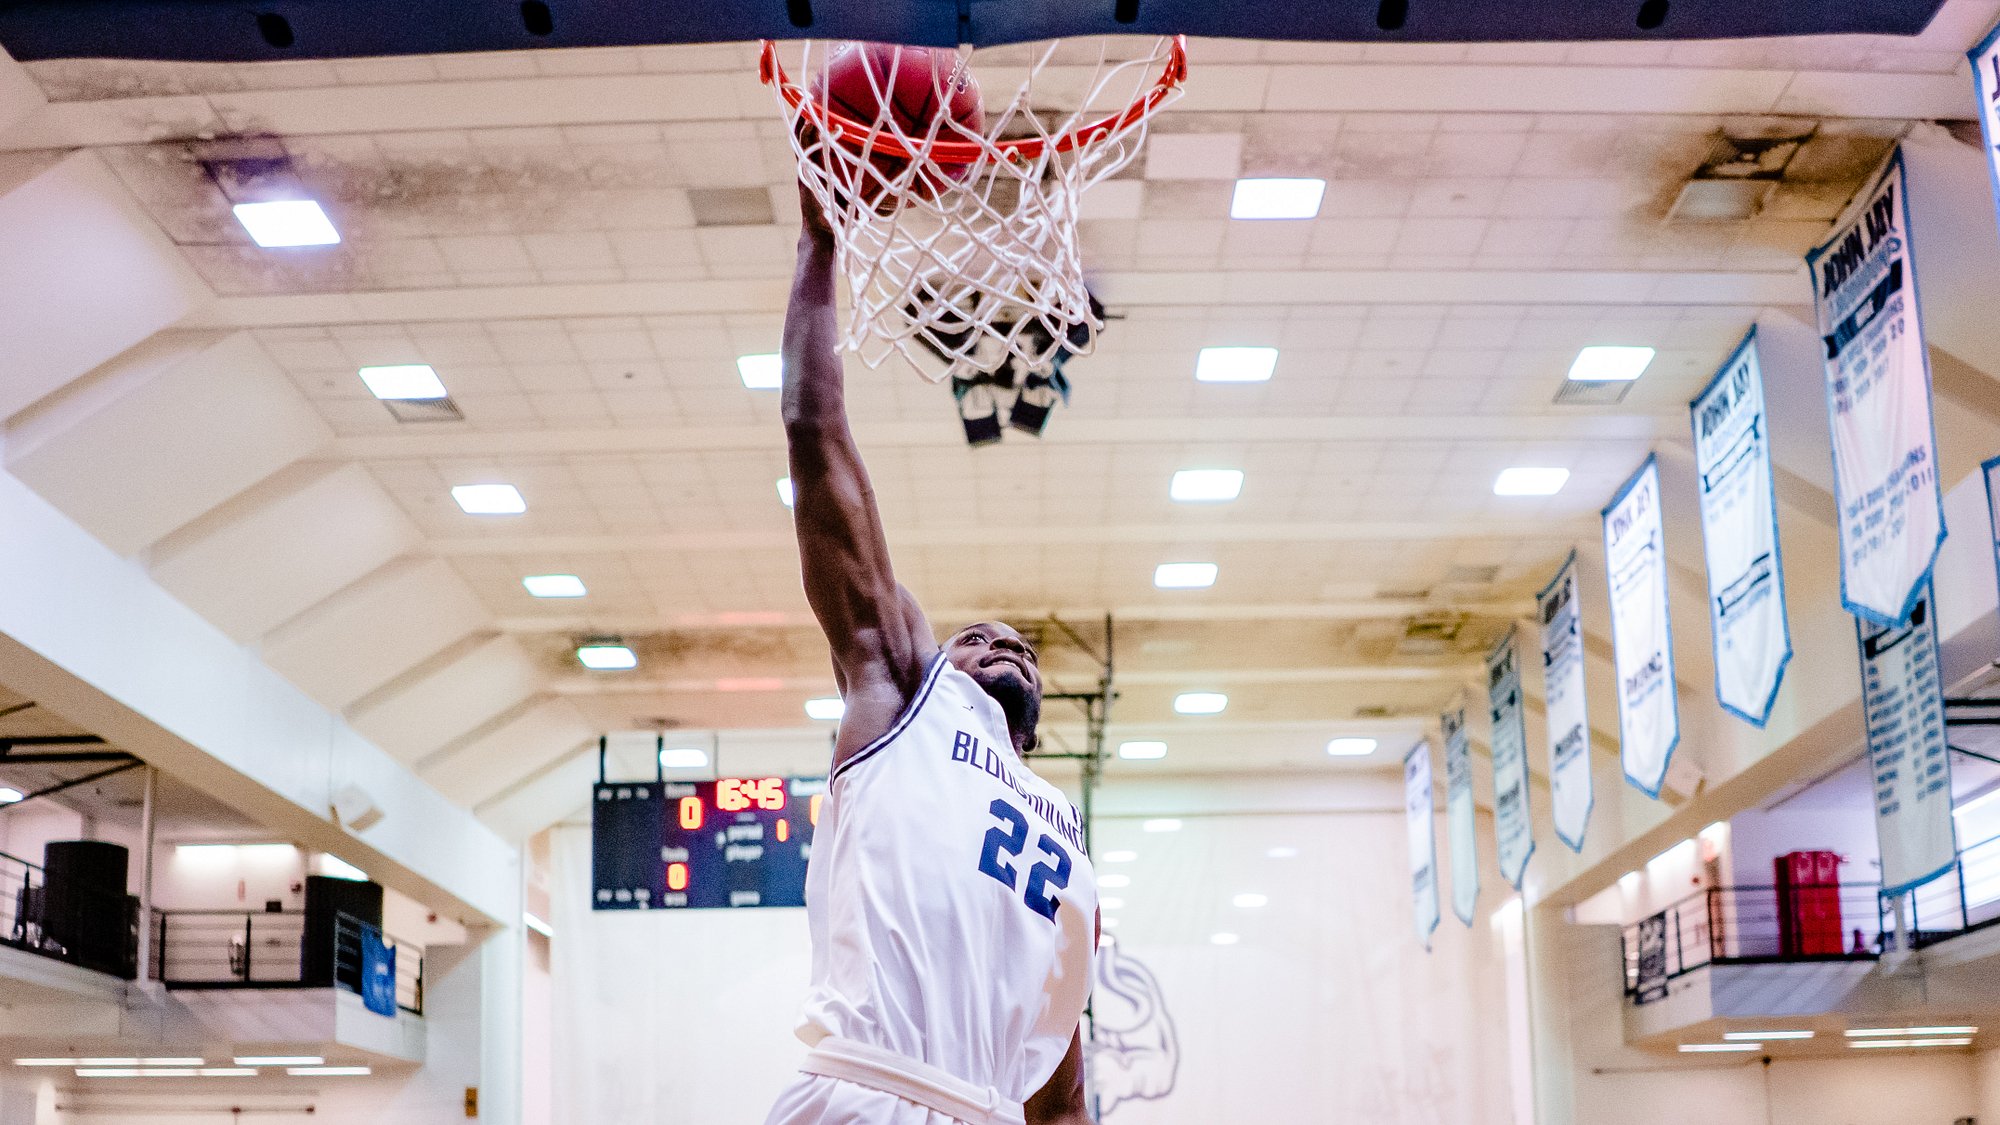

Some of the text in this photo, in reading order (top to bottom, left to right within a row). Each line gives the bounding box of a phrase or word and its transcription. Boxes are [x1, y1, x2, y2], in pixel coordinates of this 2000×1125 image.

[1823, 222, 1865, 299] JOHN
[1864, 184, 1894, 253] JAY
[716, 777, 785, 811] 16:45
[680, 796, 702, 829] 0
[667, 863, 687, 891] 0
[978, 798, 1073, 926] 22
